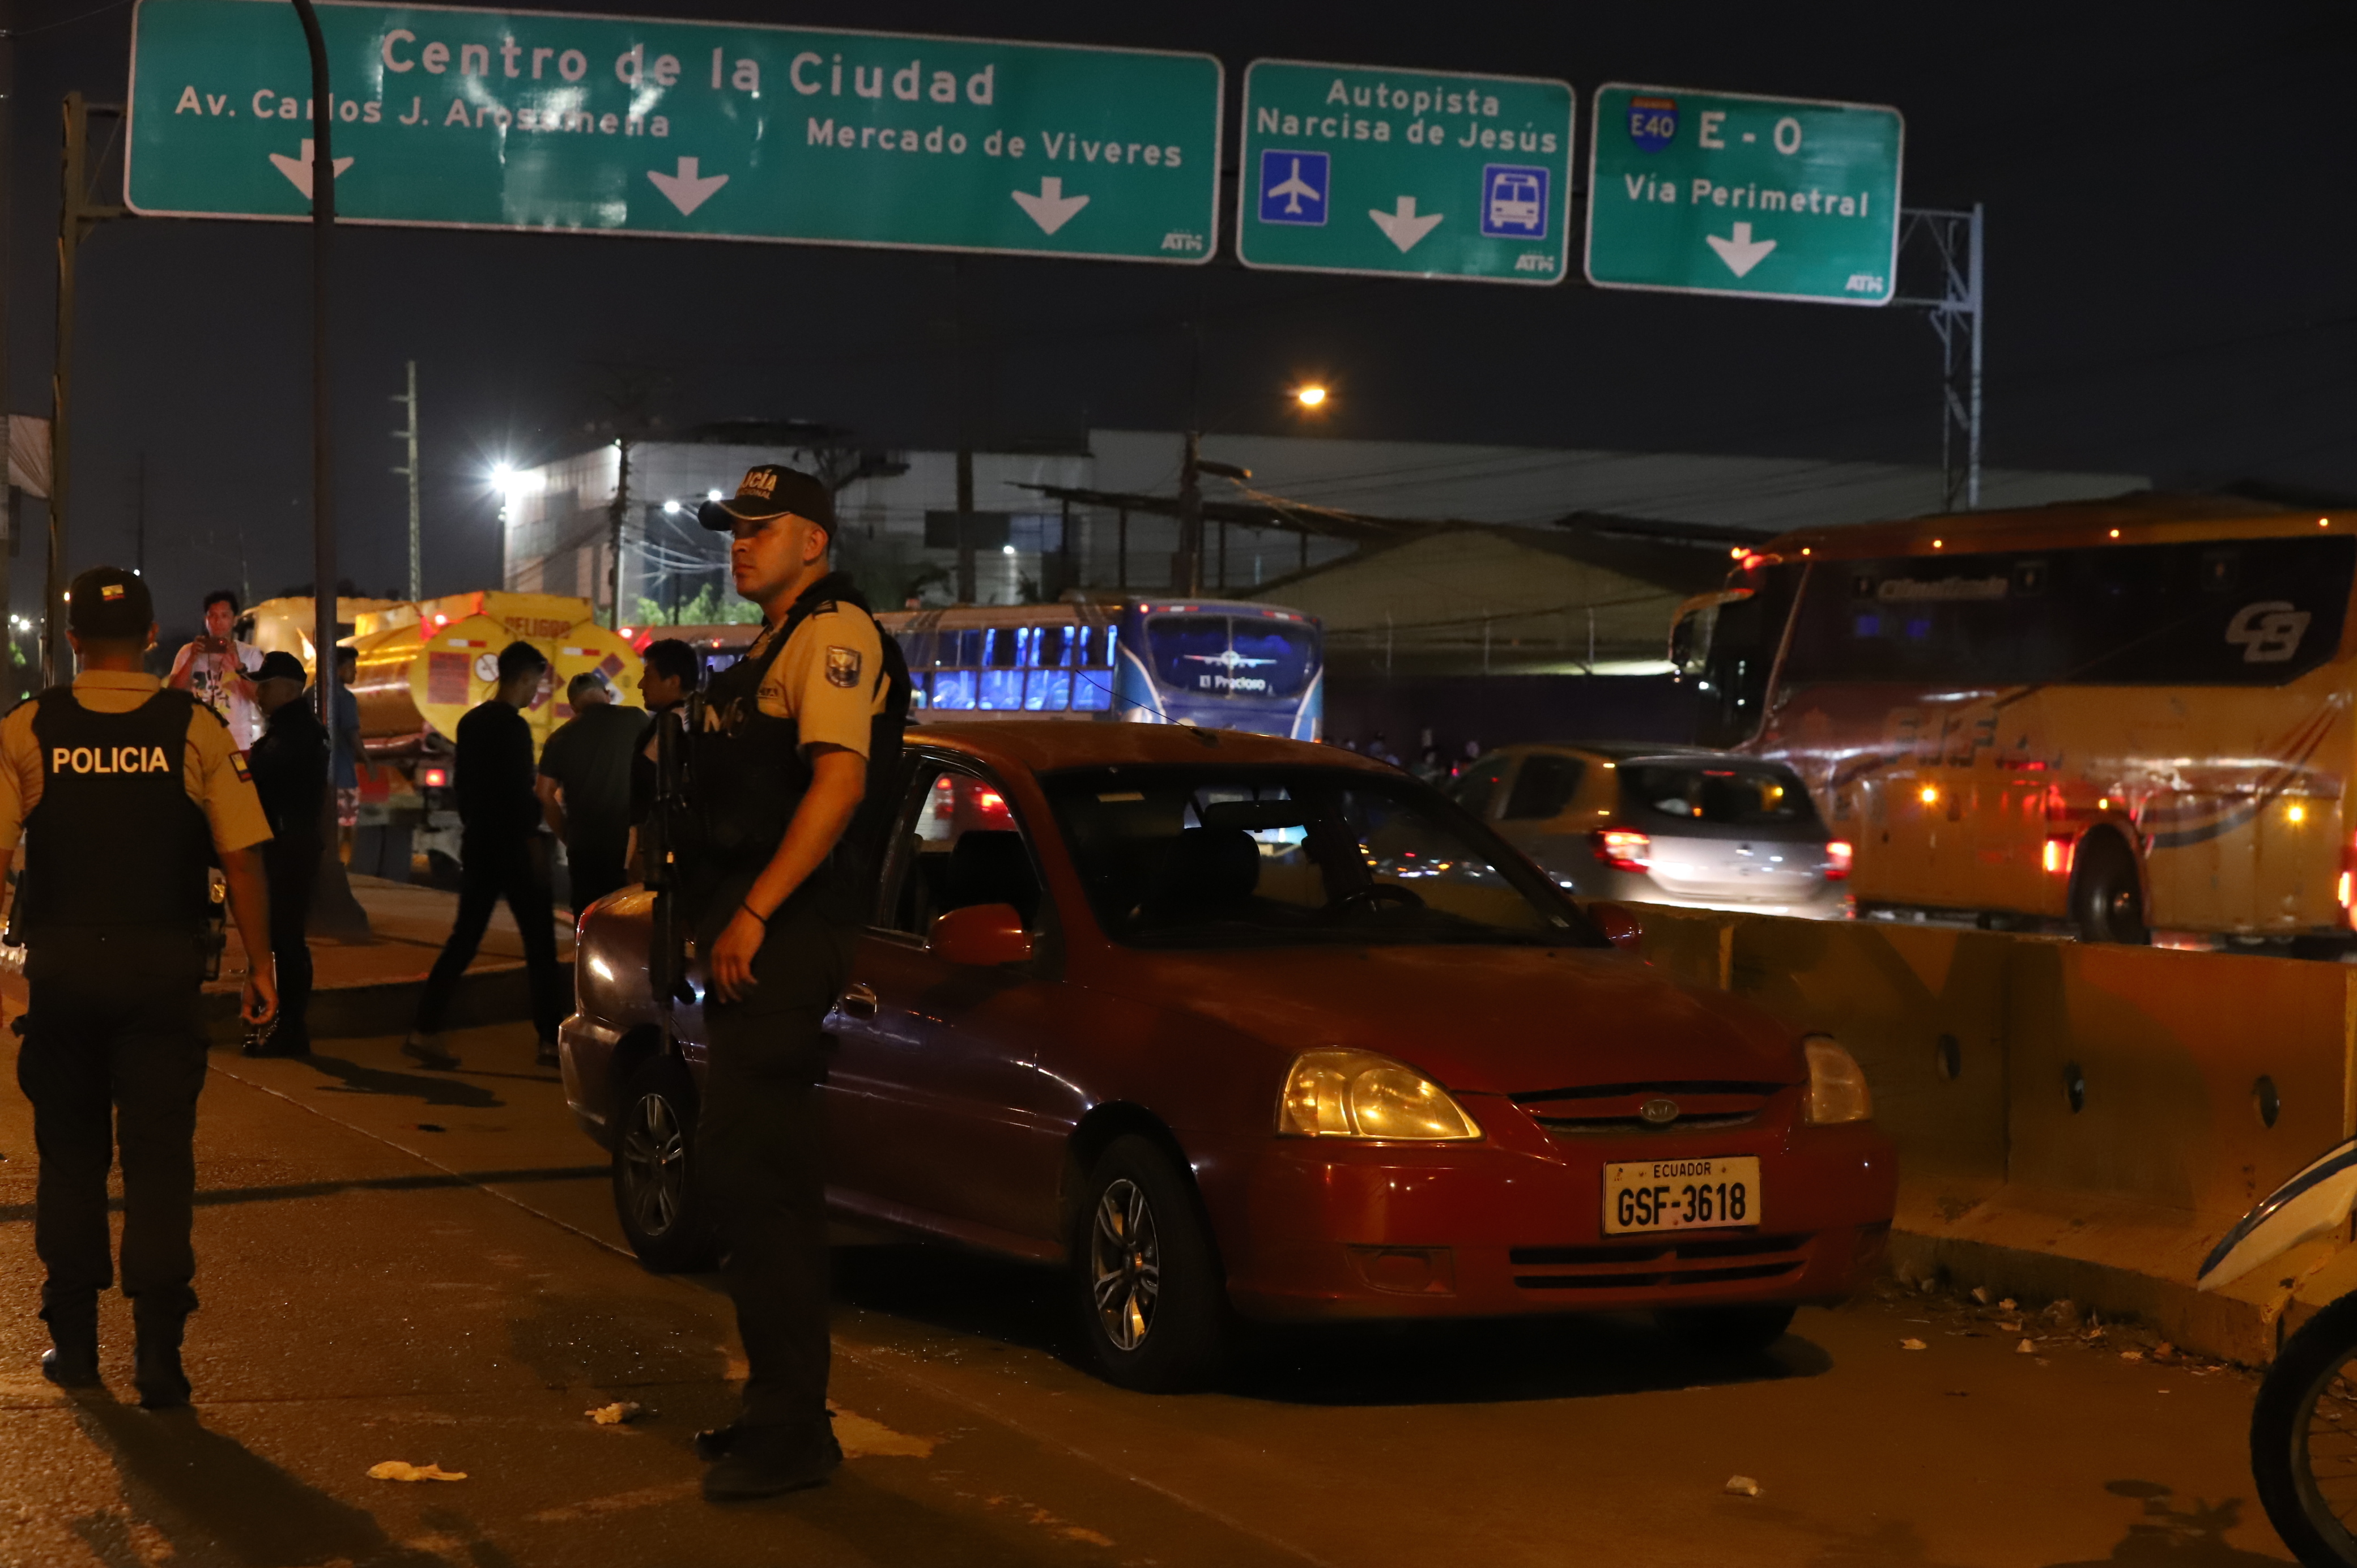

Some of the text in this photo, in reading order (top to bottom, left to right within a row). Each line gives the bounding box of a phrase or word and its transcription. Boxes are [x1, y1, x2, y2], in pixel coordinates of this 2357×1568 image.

[381, 29, 994, 105] Centro de la Ciudad
[175, 86, 235, 117] Av.
[399, 96, 429, 126] J.
[1326, 79, 1499, 116] Autopista
[807, 117, 1182, 167] Mercado de Viveres
[1257, 107, 1557, 153] Narcisa de Jesús
[1631, 116, 1674, 138] E40
[1699, 112, 1726, 149] E
[1691, 178, 1869, 218] Perimetral
[53, 747, 169, 773] POLICIA
[1653, 1161, 1712, 1179] ECUADOR
[1618, 1182, 1746, 1226] GSF-3618
